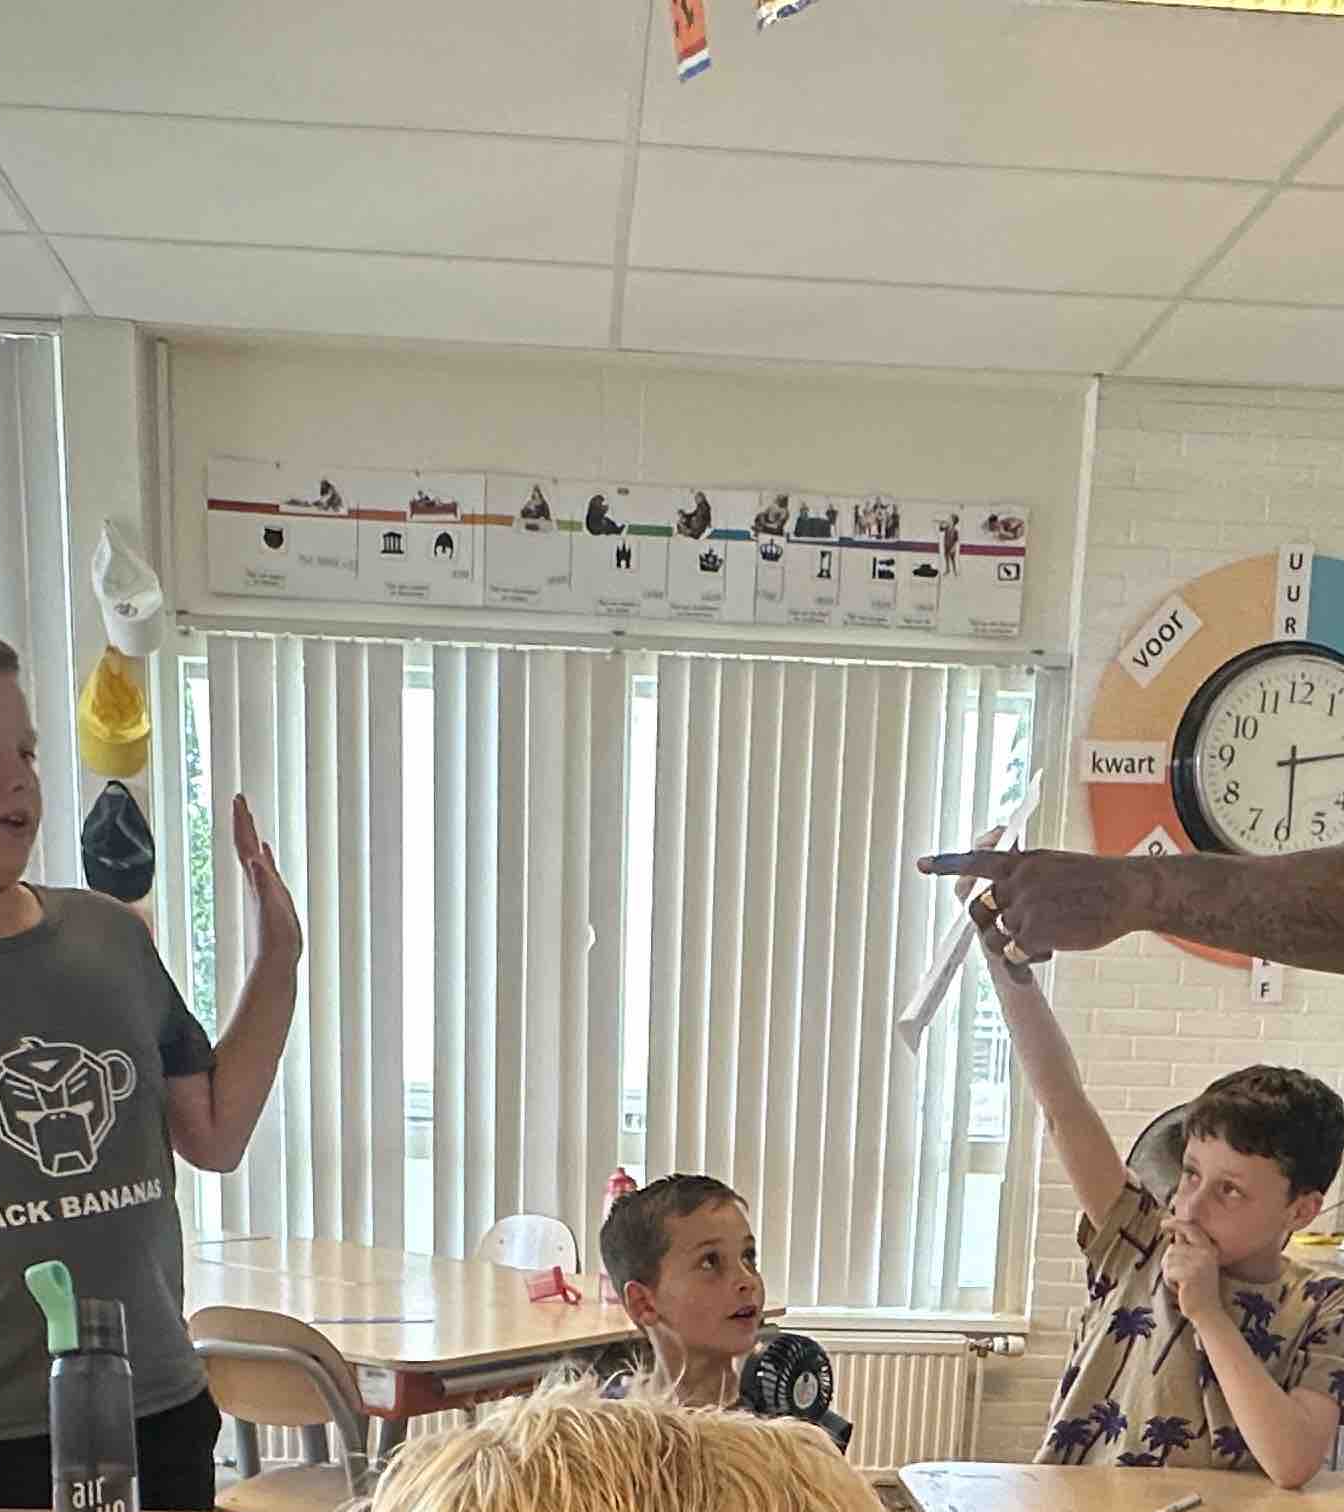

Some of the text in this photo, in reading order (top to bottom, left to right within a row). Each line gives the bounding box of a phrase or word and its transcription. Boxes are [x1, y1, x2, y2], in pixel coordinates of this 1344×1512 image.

[1132, 609, 1186, 672] voor
[1258, 689, 1280, 714] 11
[1288, 681, 1315, 706] 12
[1327, 692, 1336, 717] 1
[1233, 715, 1259, 740] 10
[1091, 748, 1156, 774] kwart
[1218, 744, 1236, 768] 9
[1223, 780, 1240, 804] 8
[1248, 807, 1264, 832] 7
[1274, 817, 1290, 842] 6
[1311, 811, 1327, 836] 5
[60, 1178, 162, 1219] BANANAS
[72, 1475, 106, 1509] air
